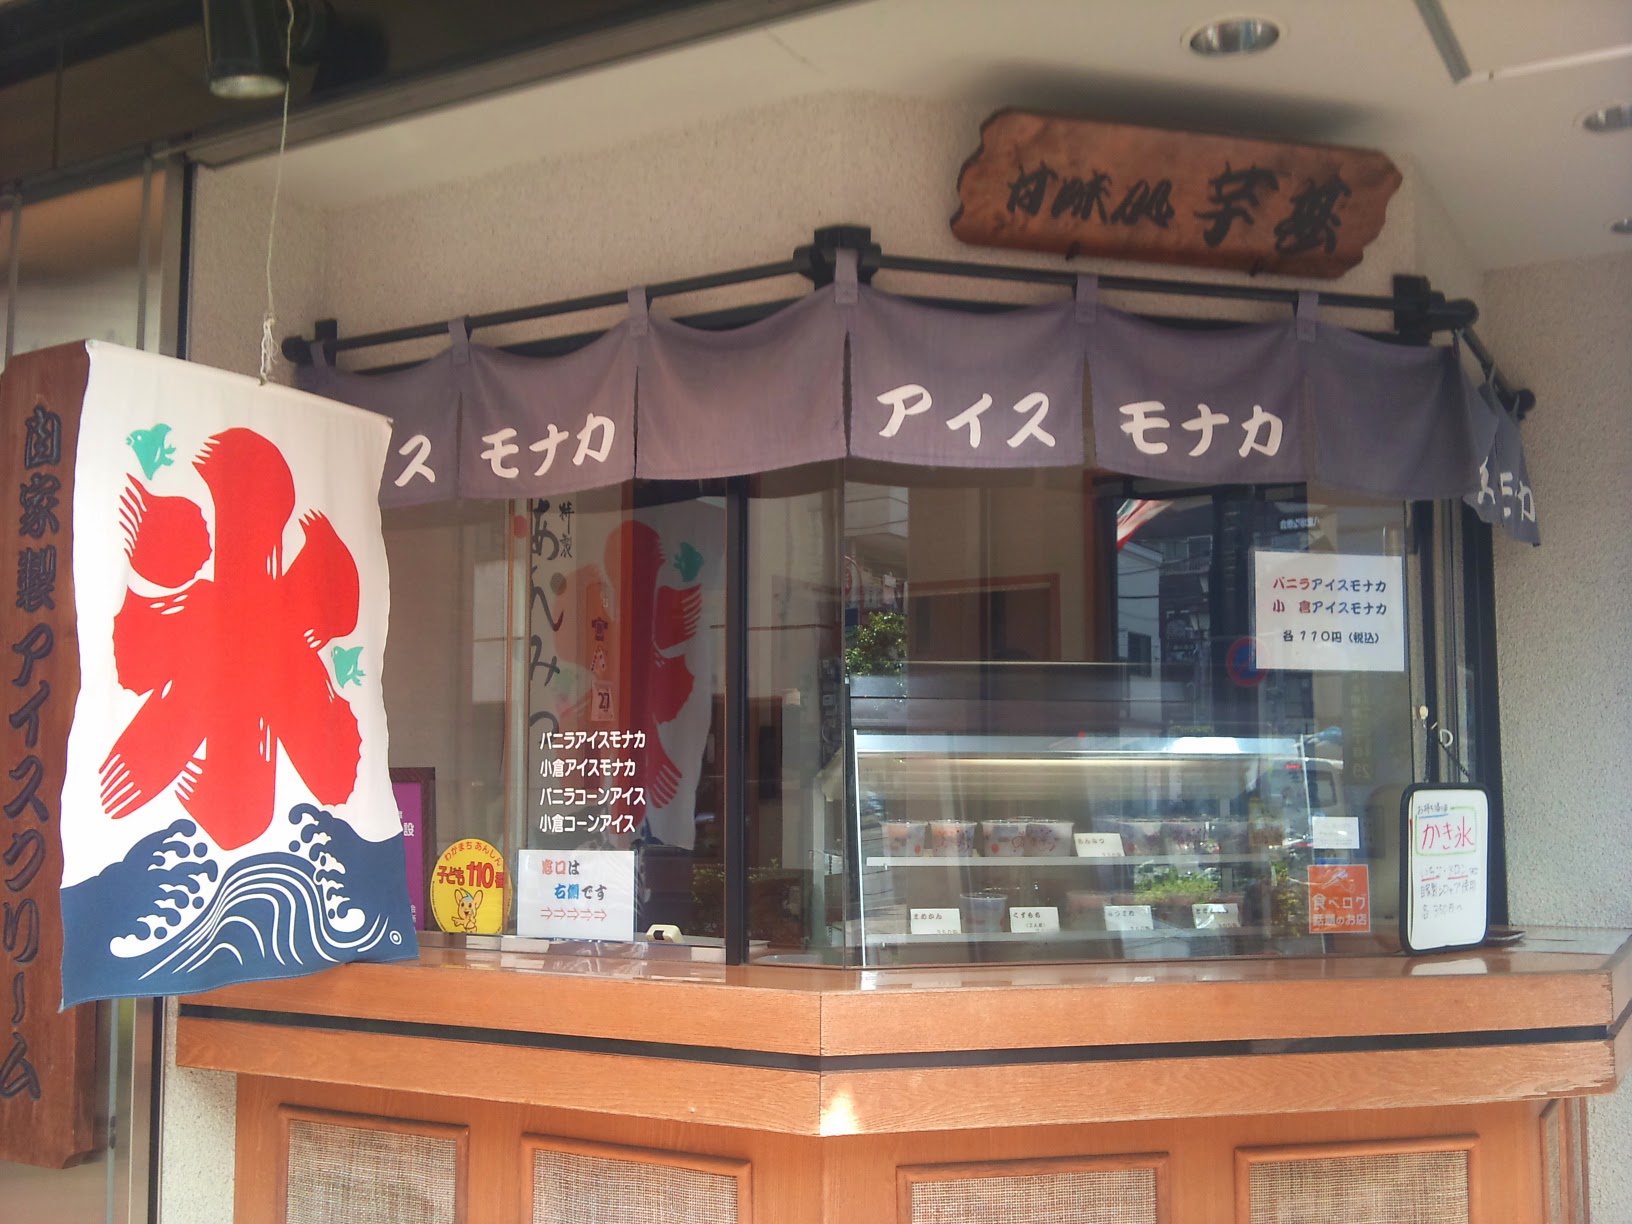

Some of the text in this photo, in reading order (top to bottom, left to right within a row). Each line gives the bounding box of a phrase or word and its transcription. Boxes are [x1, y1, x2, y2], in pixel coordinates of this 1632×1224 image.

[876, 383, 1284, 458] アイス モナカ
[480, 412, 617, 479] モナカ
[1272, 575, 1388, 593] バニラアイスモナカ
[539, 730, 646, 750] バニラアイスモナカ
[0, 404, 62, 1100] 自家製アイスクリーム
[539, 758, 636, 778] 小倉アイスモナカ
[539, 787, 646, 806] バニラコーンアイス
[539, 814, 636, 833] 小倉コーンアイス
[1421, 815, 1475, 850] かき氷
[541, 859, 580, 876] 窓口は
[554, 883, 608, 901] 右側です
